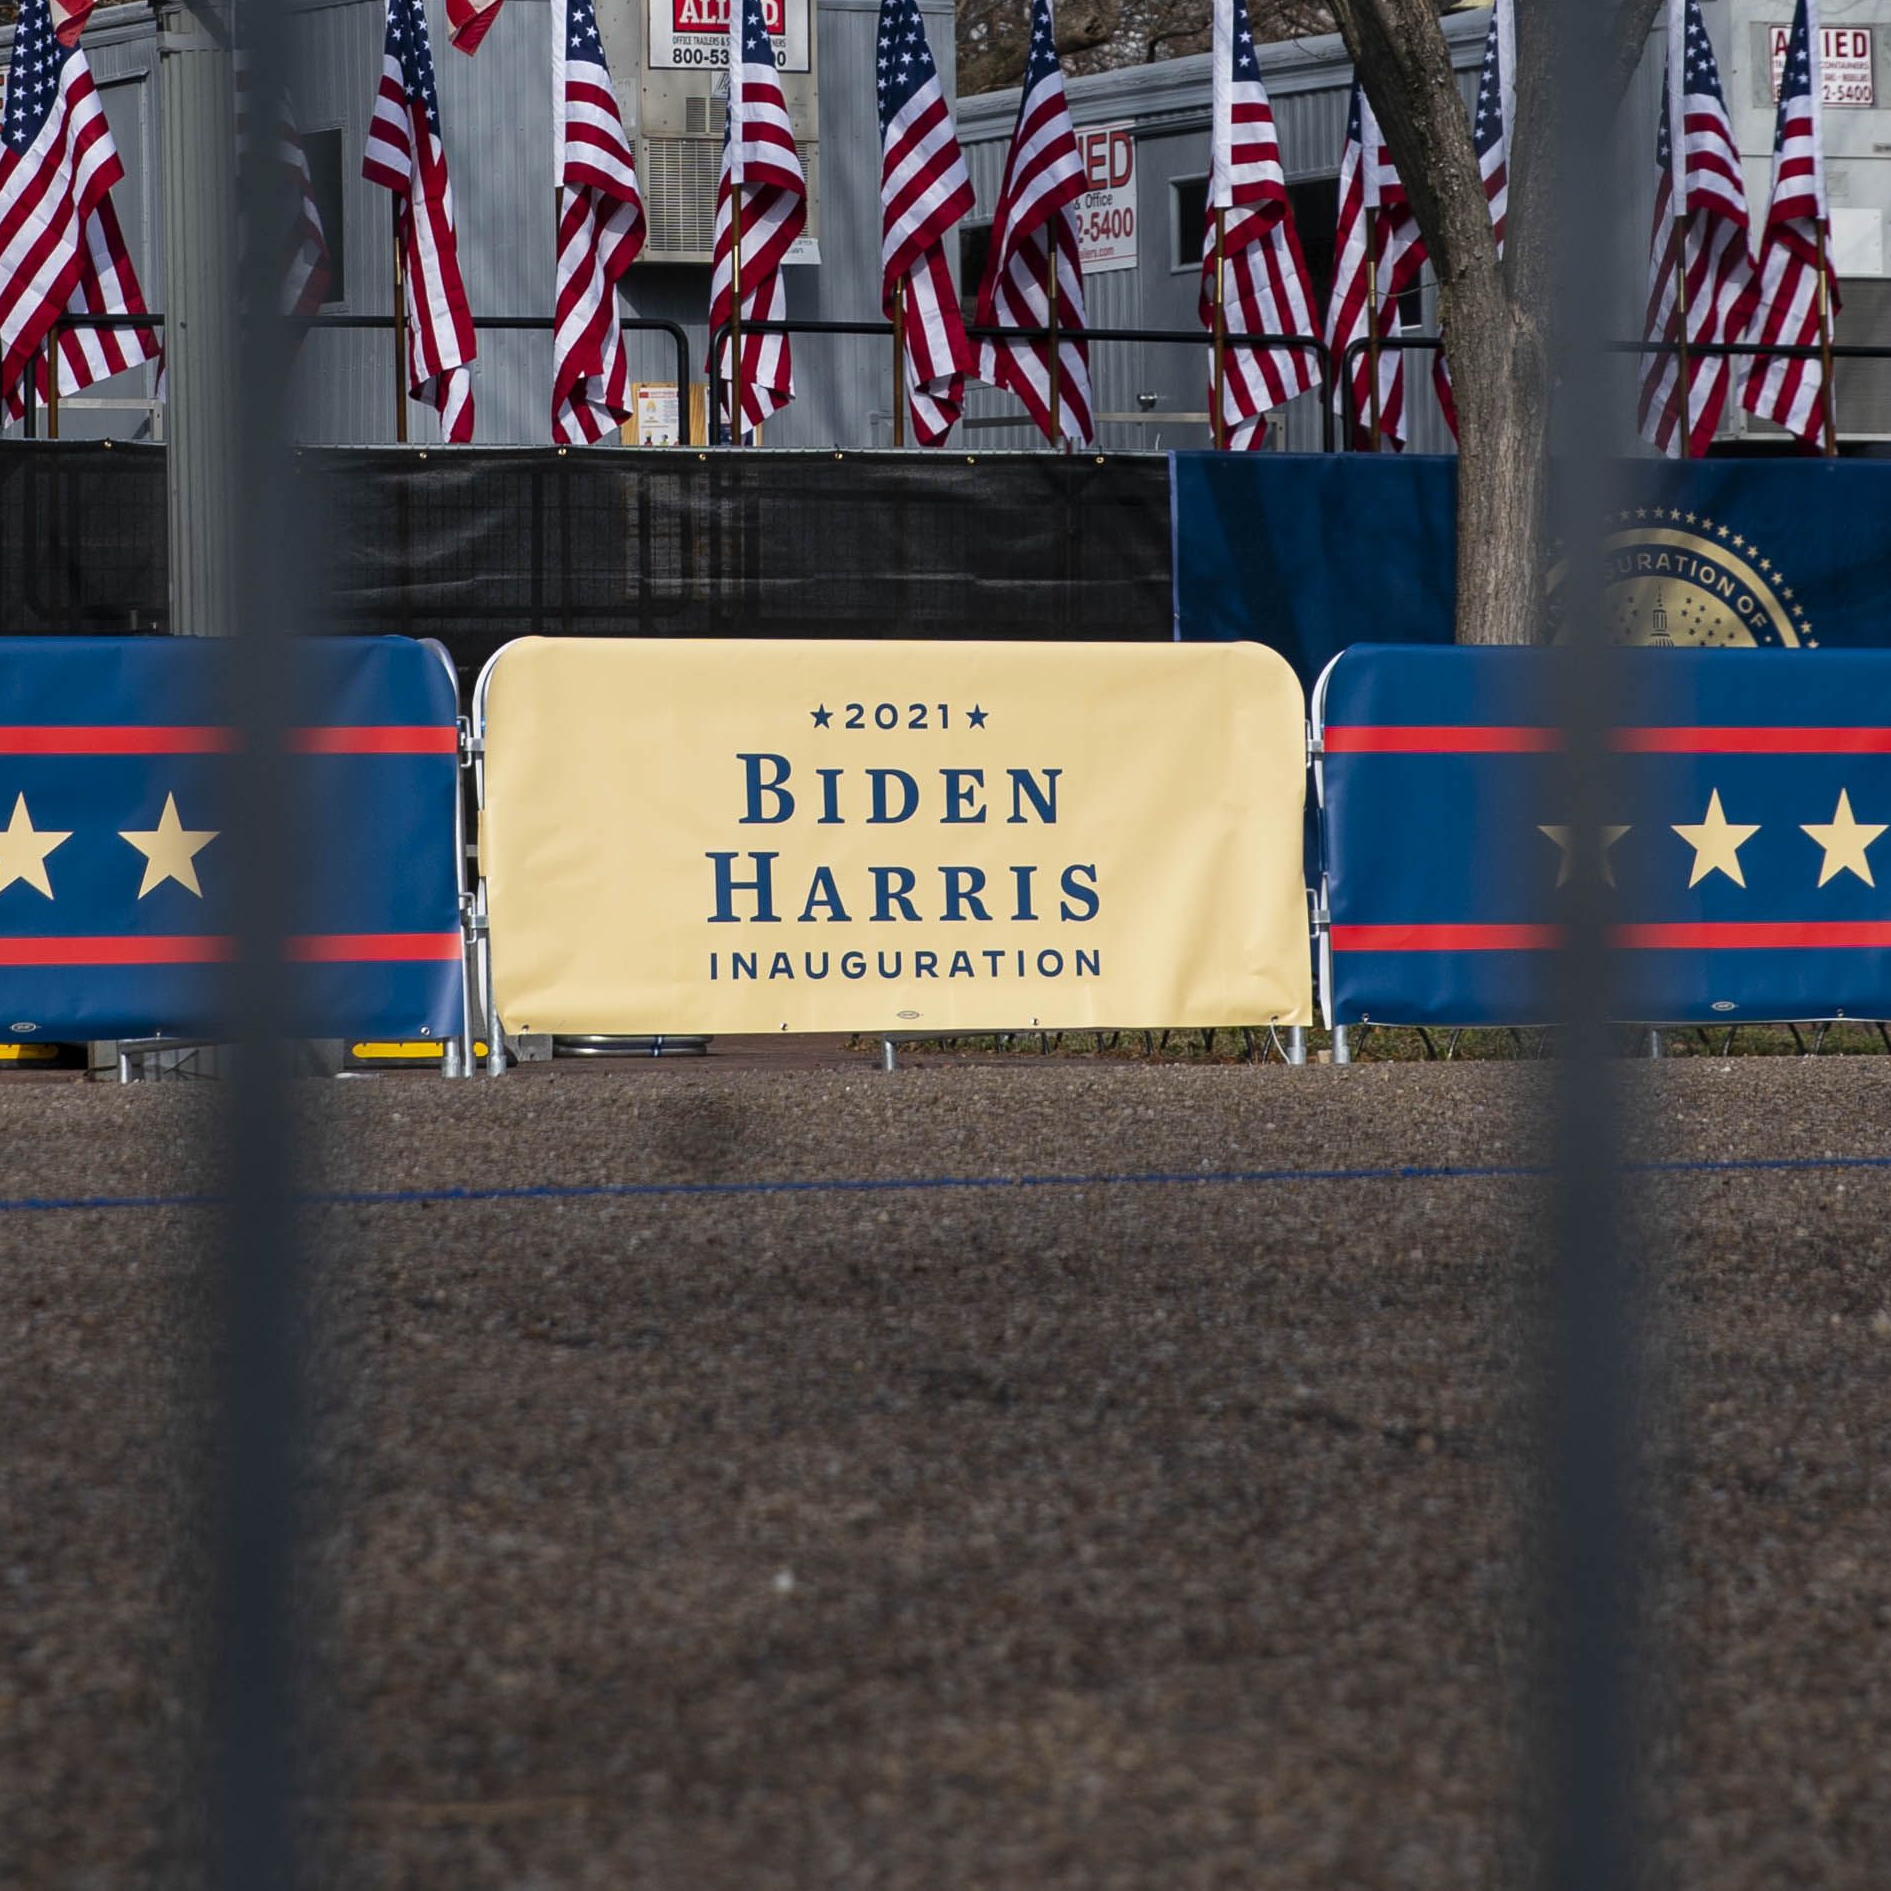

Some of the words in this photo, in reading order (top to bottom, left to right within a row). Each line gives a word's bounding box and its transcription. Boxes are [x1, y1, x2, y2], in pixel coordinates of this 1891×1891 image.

[672, 35, 692, 46] OFFICE
[693, 36, 719, 47] TRAILERS
[1774, 30, 1868, 58] AIED
[672, 48, 786, 67] 800-530
[1085, 192, 1113, 209] Office
[1076, 207, 1134, 243] 2-5400
[1736, 595, 1768, 629] OF
[844, 703, 949, 730] 2021
[736, 752, 1063, 825] BIDEN
[705, 851, 1100, 923] HARRIS
[710, 949, 1101, 981] INAUGURATION
